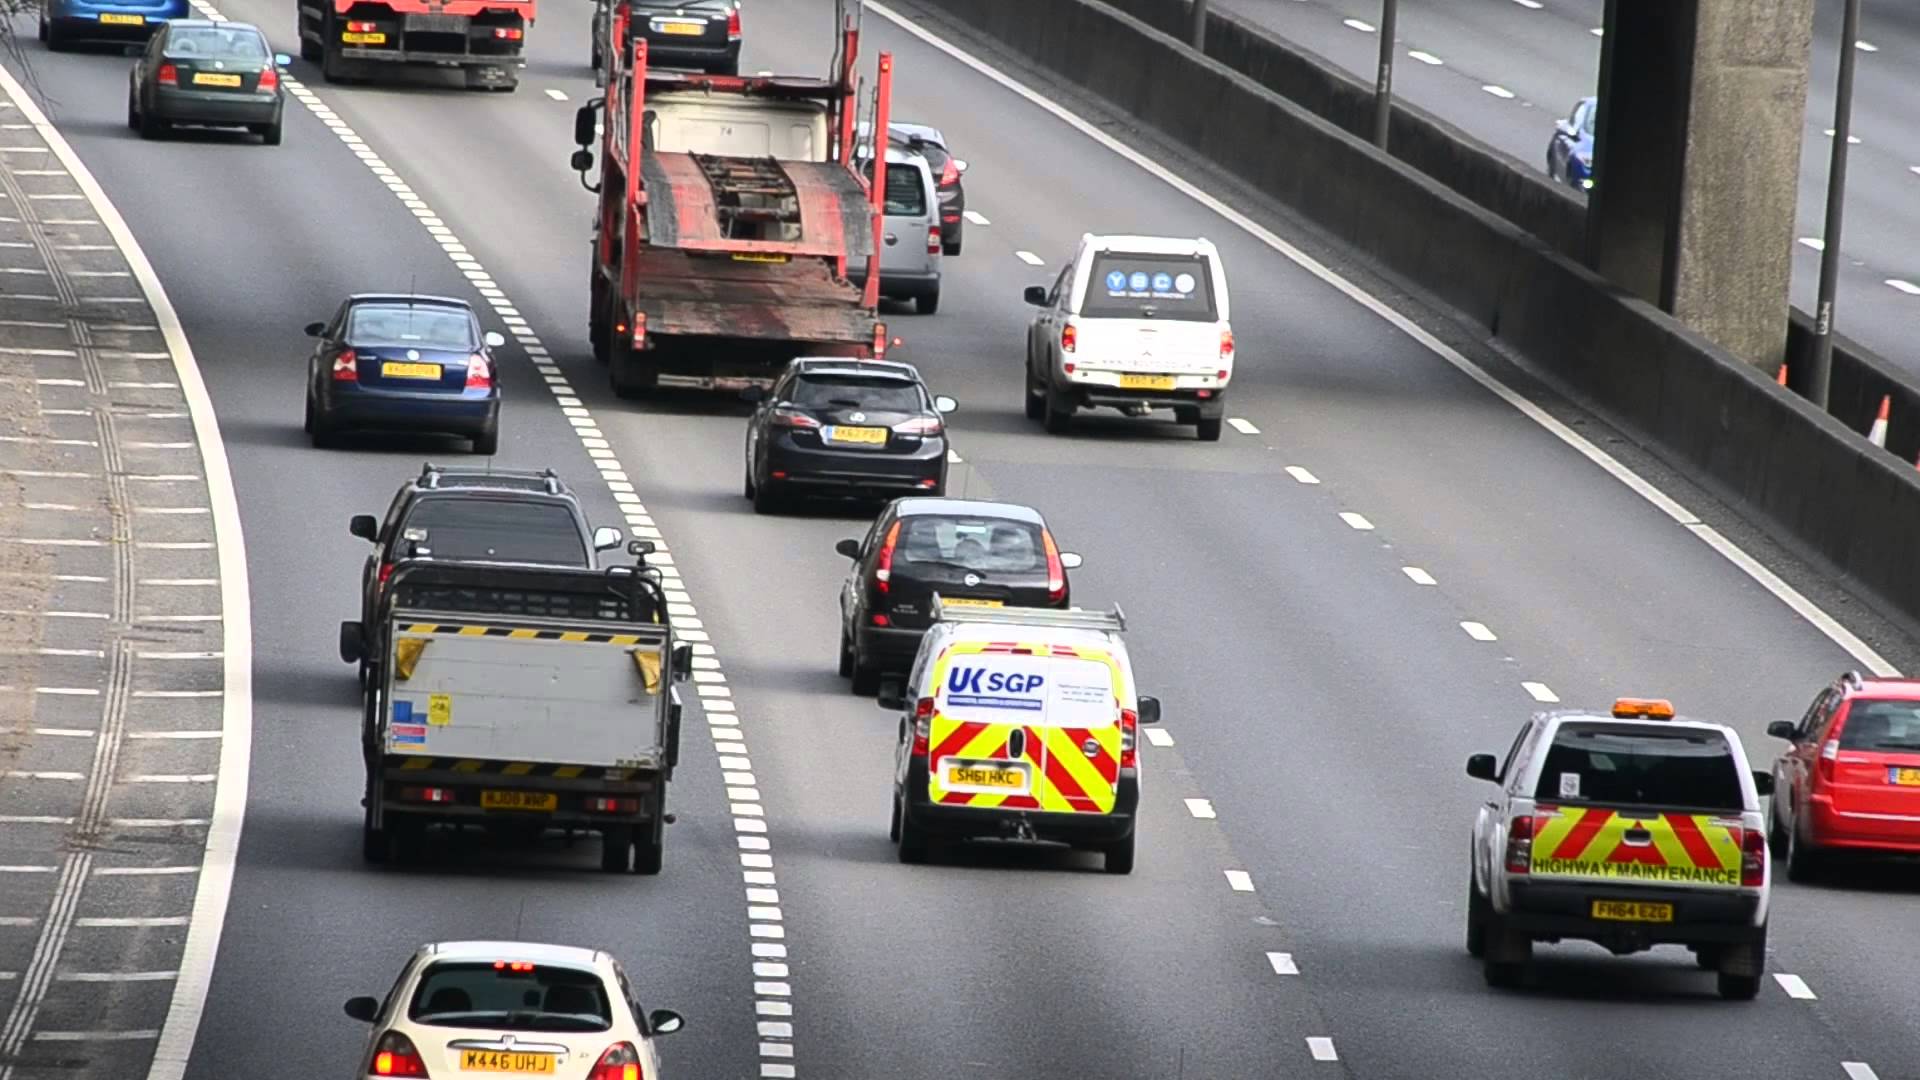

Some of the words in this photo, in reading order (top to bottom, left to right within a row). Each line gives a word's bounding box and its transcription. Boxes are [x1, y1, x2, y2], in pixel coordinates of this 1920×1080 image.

[987, 672, 1044, 693] SGP
[957, 768, 986, 782] SH61
[989, 770, 1013, 784] HKC
[1533, 858, 1612, 874] HIGHWAY
[1616, 861, 1738, 885] MAINTENANCE
[1597, 902, 1636, 917] FH64
[1639, 904, 1669, 919] EZG
[467, 1051, 510, 1070] W446
[515, 1054, 547, 1072] UHJ
